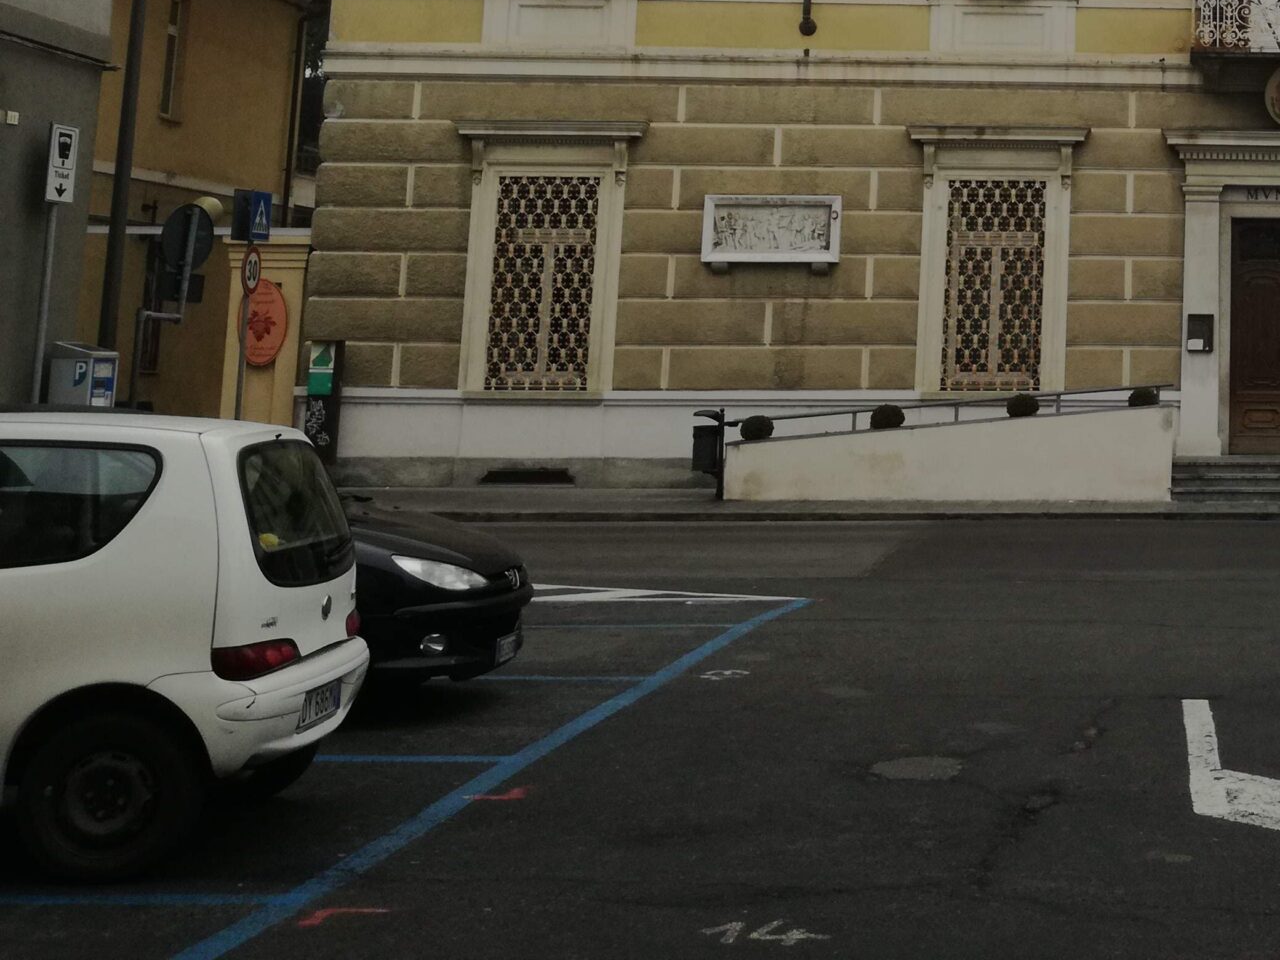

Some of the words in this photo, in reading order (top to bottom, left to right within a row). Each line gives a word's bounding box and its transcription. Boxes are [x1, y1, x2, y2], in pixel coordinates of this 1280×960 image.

[54, 170, 70, 180] Ticket
[246, 260, 258, 282] 30
[75, 362, 87, 381] P
